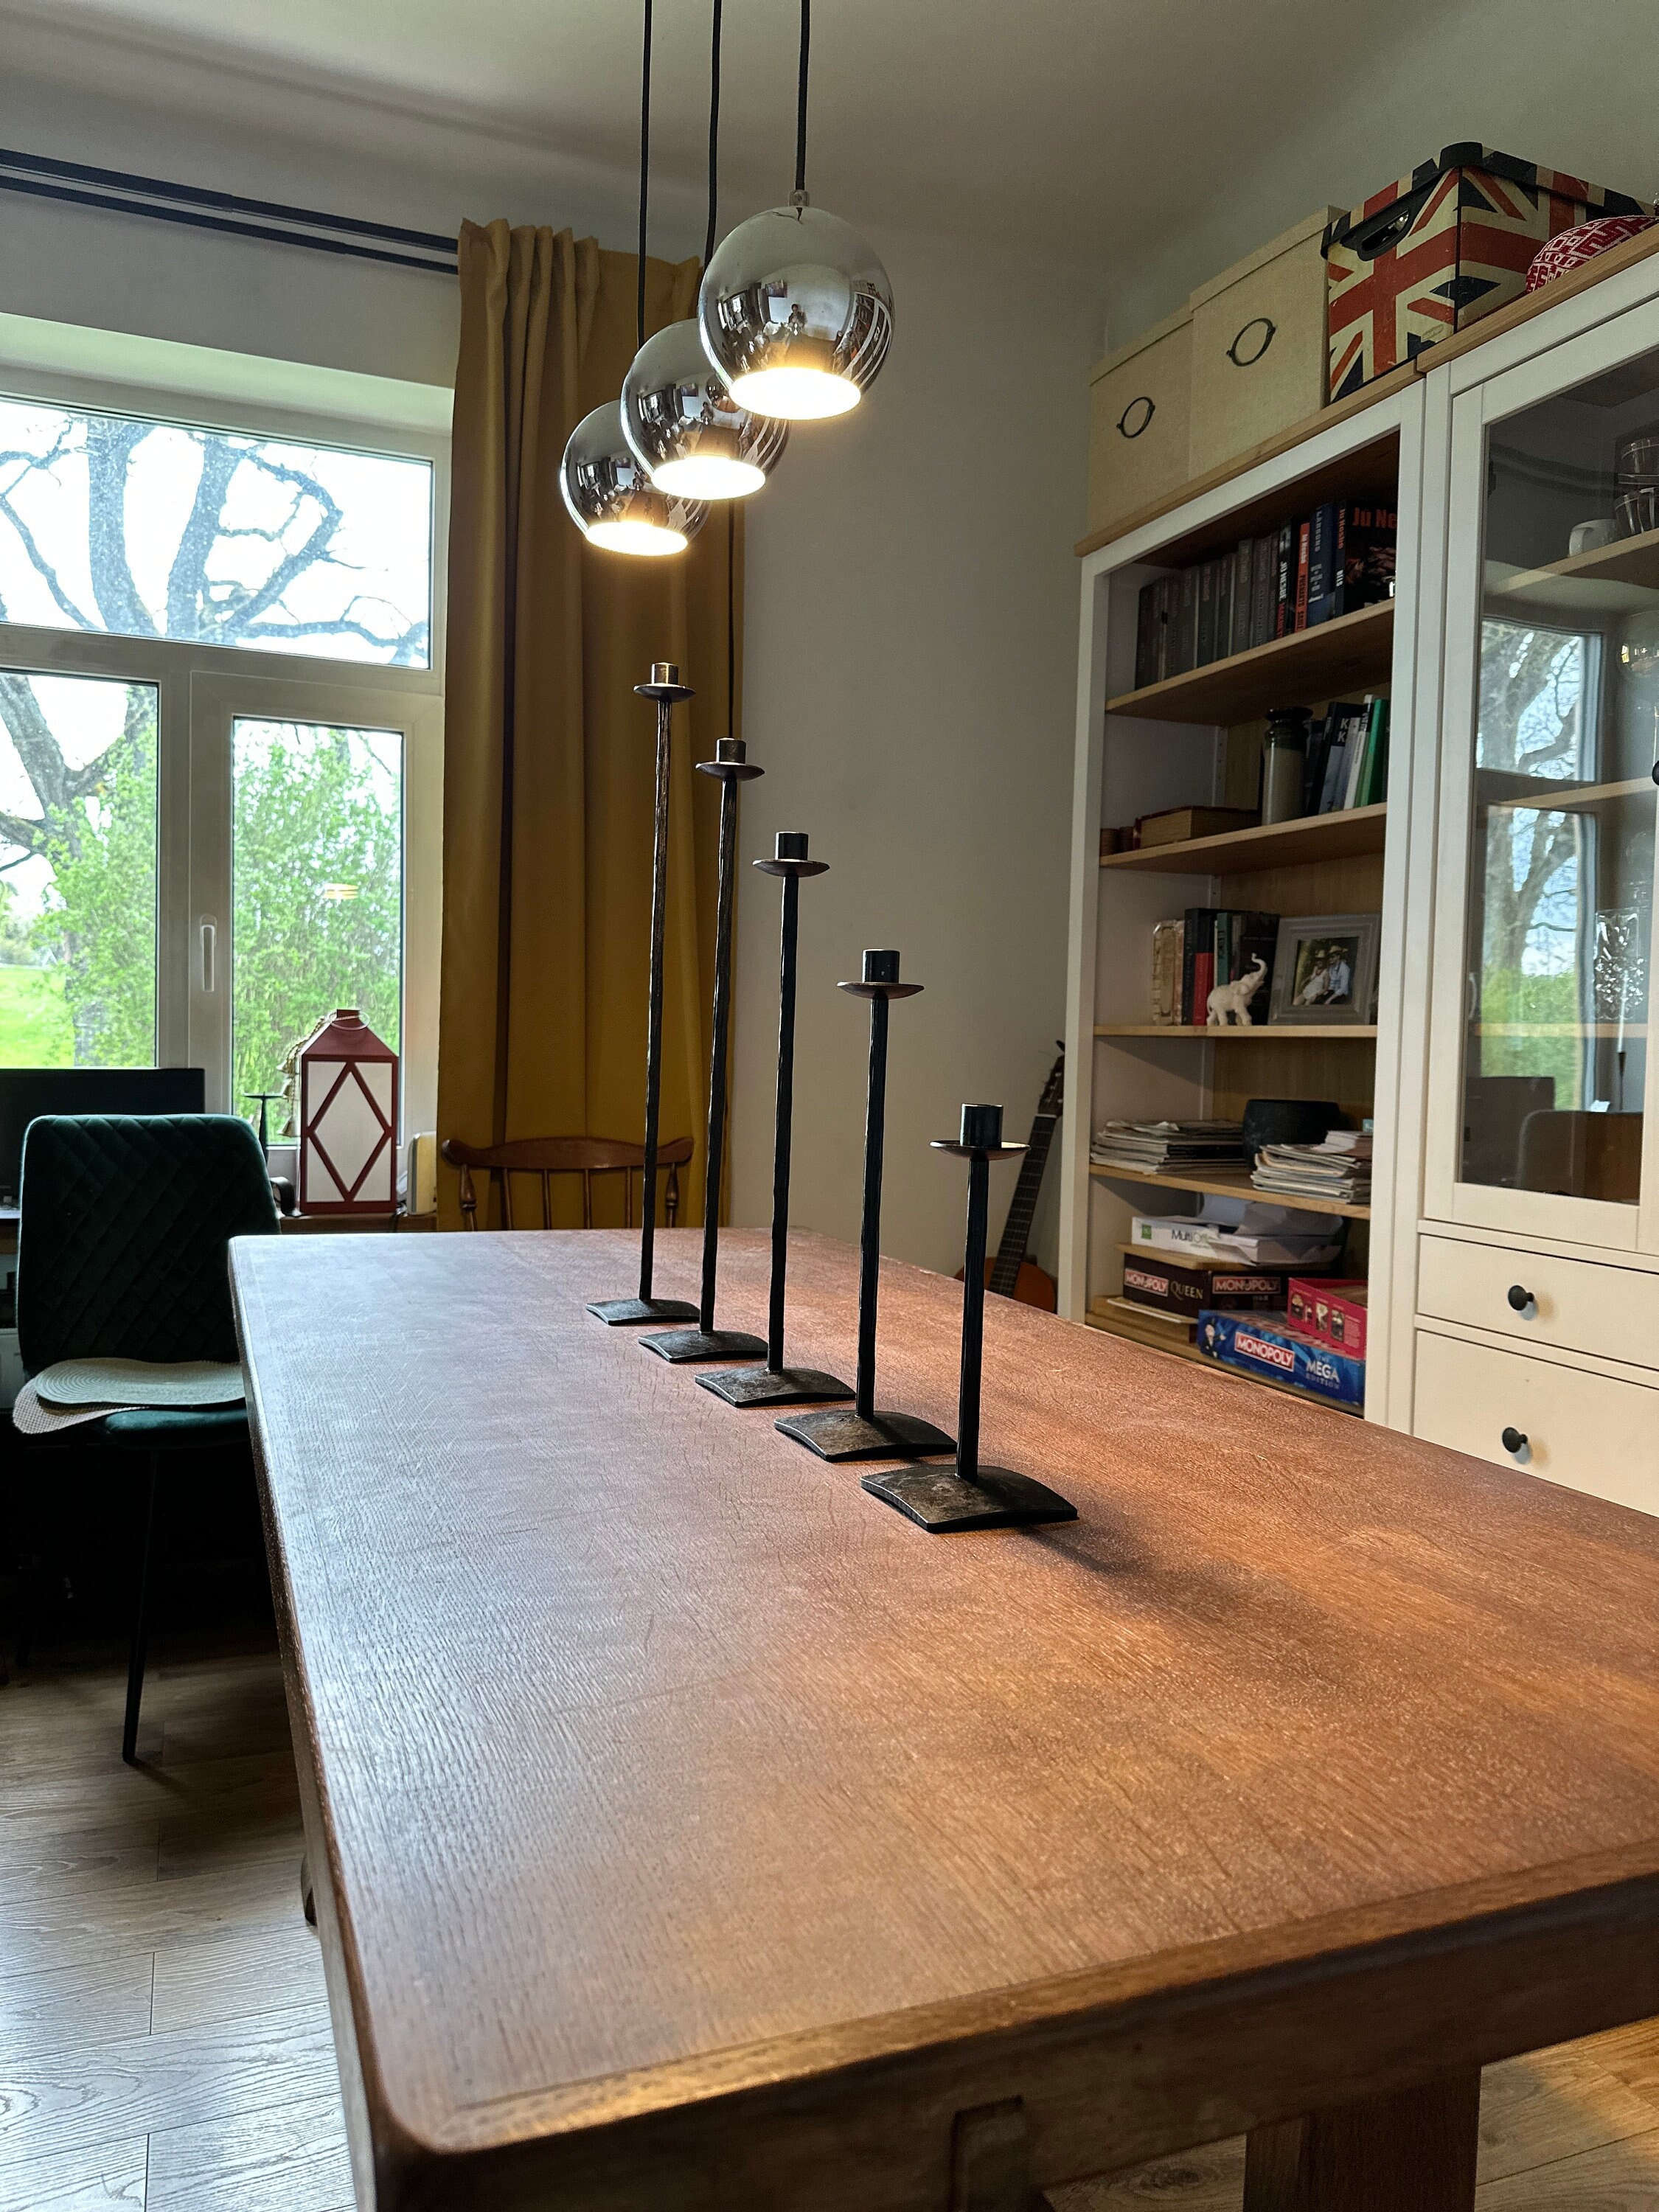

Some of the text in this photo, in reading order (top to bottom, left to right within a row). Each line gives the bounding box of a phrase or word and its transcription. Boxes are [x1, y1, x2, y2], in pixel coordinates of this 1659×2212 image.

[1126, 1273, 1203, 1301] MONOPOLY QUEEN
[1215, 1279, 1279, 1291] MONOPOLY
[1237, 1337, 1293, 1366] MONOPOLY
[1306, 1359, 1340, 1383] MEGA
[1306, 1373, 1340, 1390] EDITION
